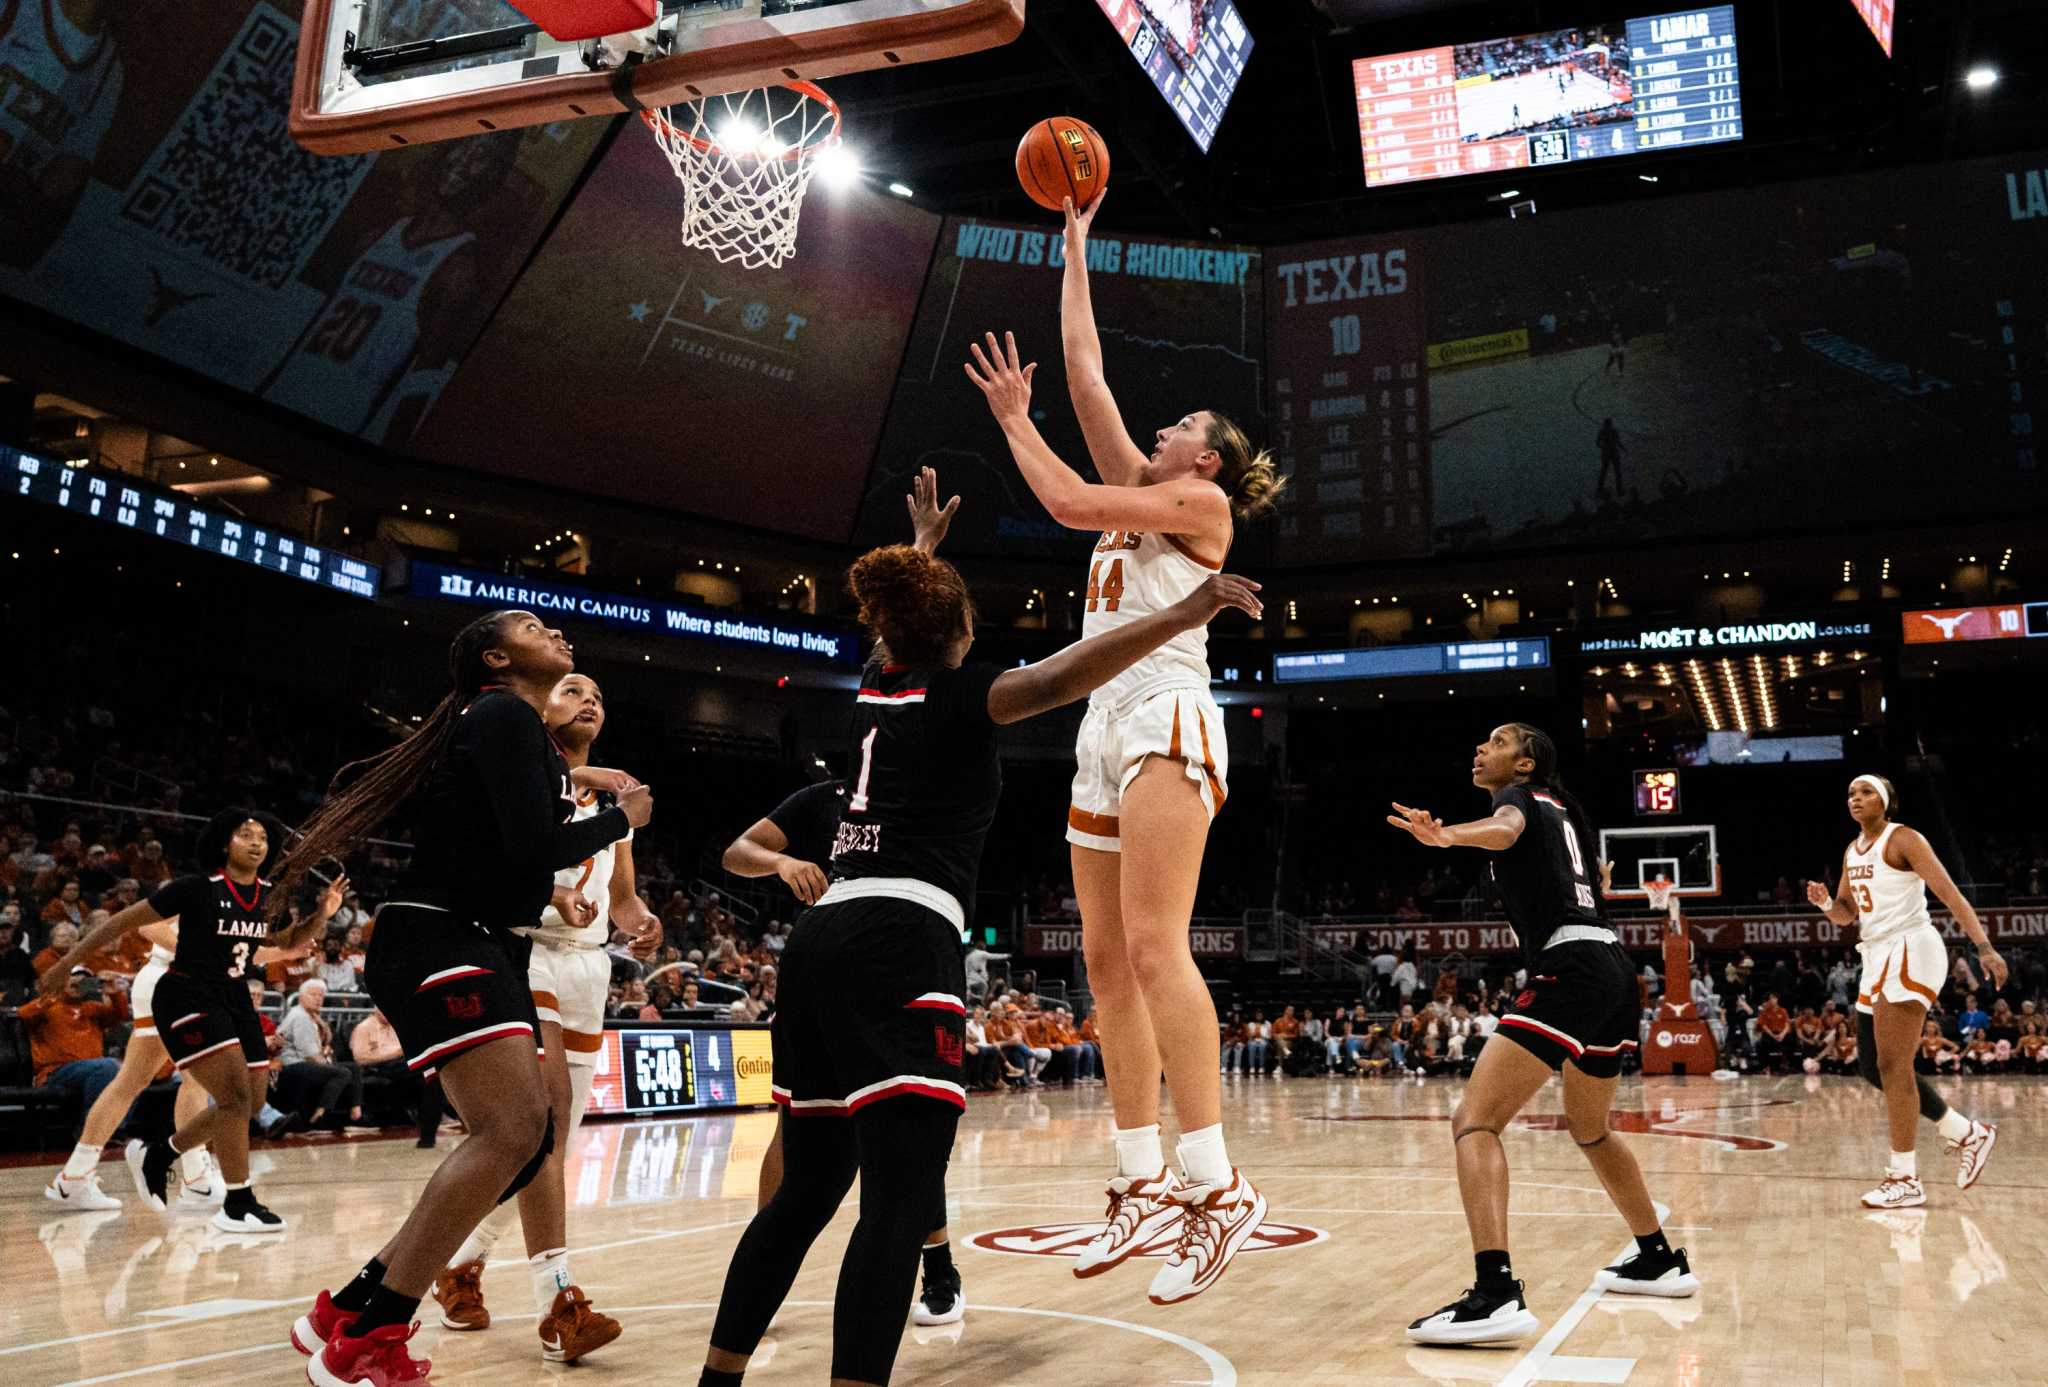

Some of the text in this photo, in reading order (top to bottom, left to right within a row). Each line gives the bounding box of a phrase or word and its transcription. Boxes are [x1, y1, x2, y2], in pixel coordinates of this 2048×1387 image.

[1650, 13, 1710, 43] LAMAR
[1371, 54, 1438, 81] TEXAS
[2005, 168, 2048, 221] LA
[956, 224, 1017, 263] WHO
[1017, 231, 1047, 266] IS
[1126, 242, 1249, 287] #HOOKEM?
[1277, 248, 1408, 308] TEXAS
[1329, 314, 1361, 356] 10
[19, 454, 40, 476] REB
[60, 469, 75, 487] FT
[89, 478, 107, 498] FTA
[19, 477, 31, 495] 2
[59, 488, 70, 507] 0
[90, 498, 101, 516] 0
[156, 518, 166, 536] 0
[191, 528, 200, 545] 0
[475, 581, 651, 623] AMERICAN CAMPUS
[1086, 558, 1124, 612] 44
[666, 609, 712, 635] Where
[714, 617, 771, 643] students
[772, 625, 799, 648] love
[1640, 627, 1695, 650] MOËT
[1698, 628, 1714, 646] &
[1716, 621, 1817, 644] CHANDON
[1998, 609, 2019, 632] 10
[849, 726, 878, 811] 1
[1652, 787, 1673, 810] 15
[1191, 931, 1235, 952] RNS
[1439, 929, 1470, 950] TO
[1743, 922, 1810, 943] HOME
[1997, 914, 2048, 937] LON
[227, 942, 250, 978] 3
[1674, 1033, 1704, 1045] razr
[635, 1049, 682, 1091] 5:48
[708, 1035, 720, 1072] 4
[737, 1055, 771, 1079] Contin
